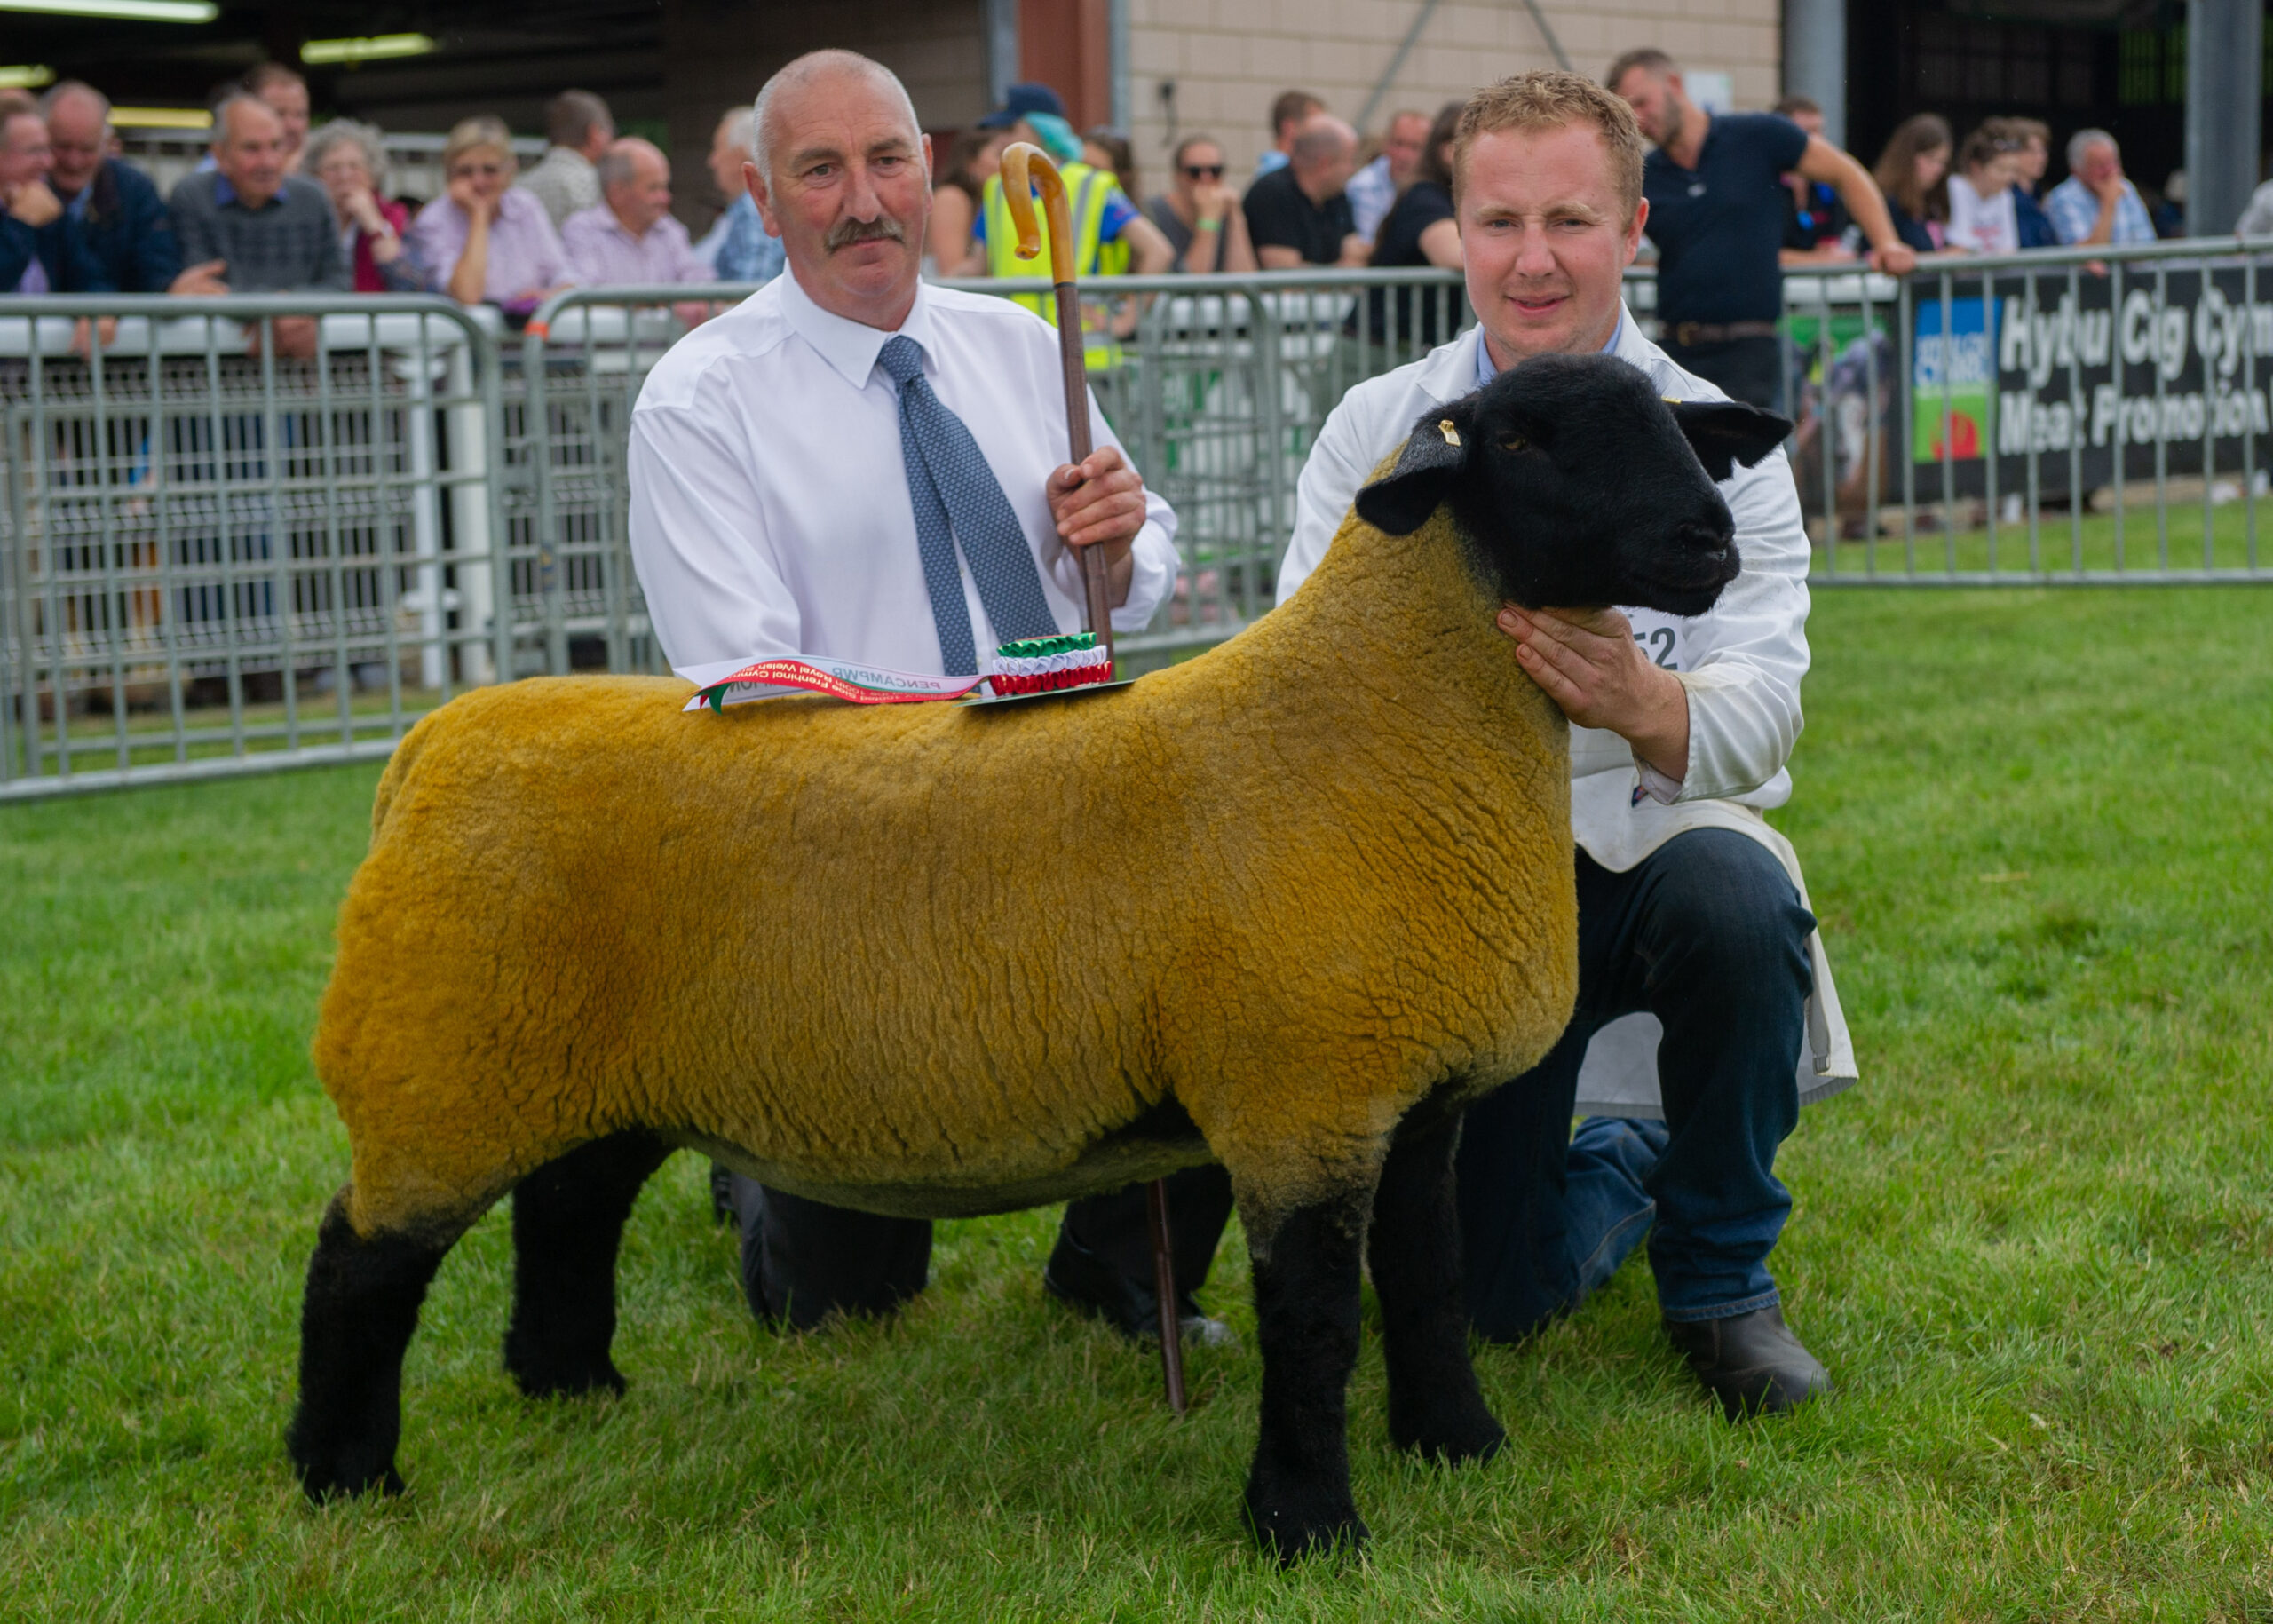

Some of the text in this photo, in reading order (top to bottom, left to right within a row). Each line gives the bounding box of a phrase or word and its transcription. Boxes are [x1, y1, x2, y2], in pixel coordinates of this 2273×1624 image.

[758, 662, 796, 673] Welsh
[799, 666, 832, 683] Royal
[772, 671, 828, 689] Frenhinol
